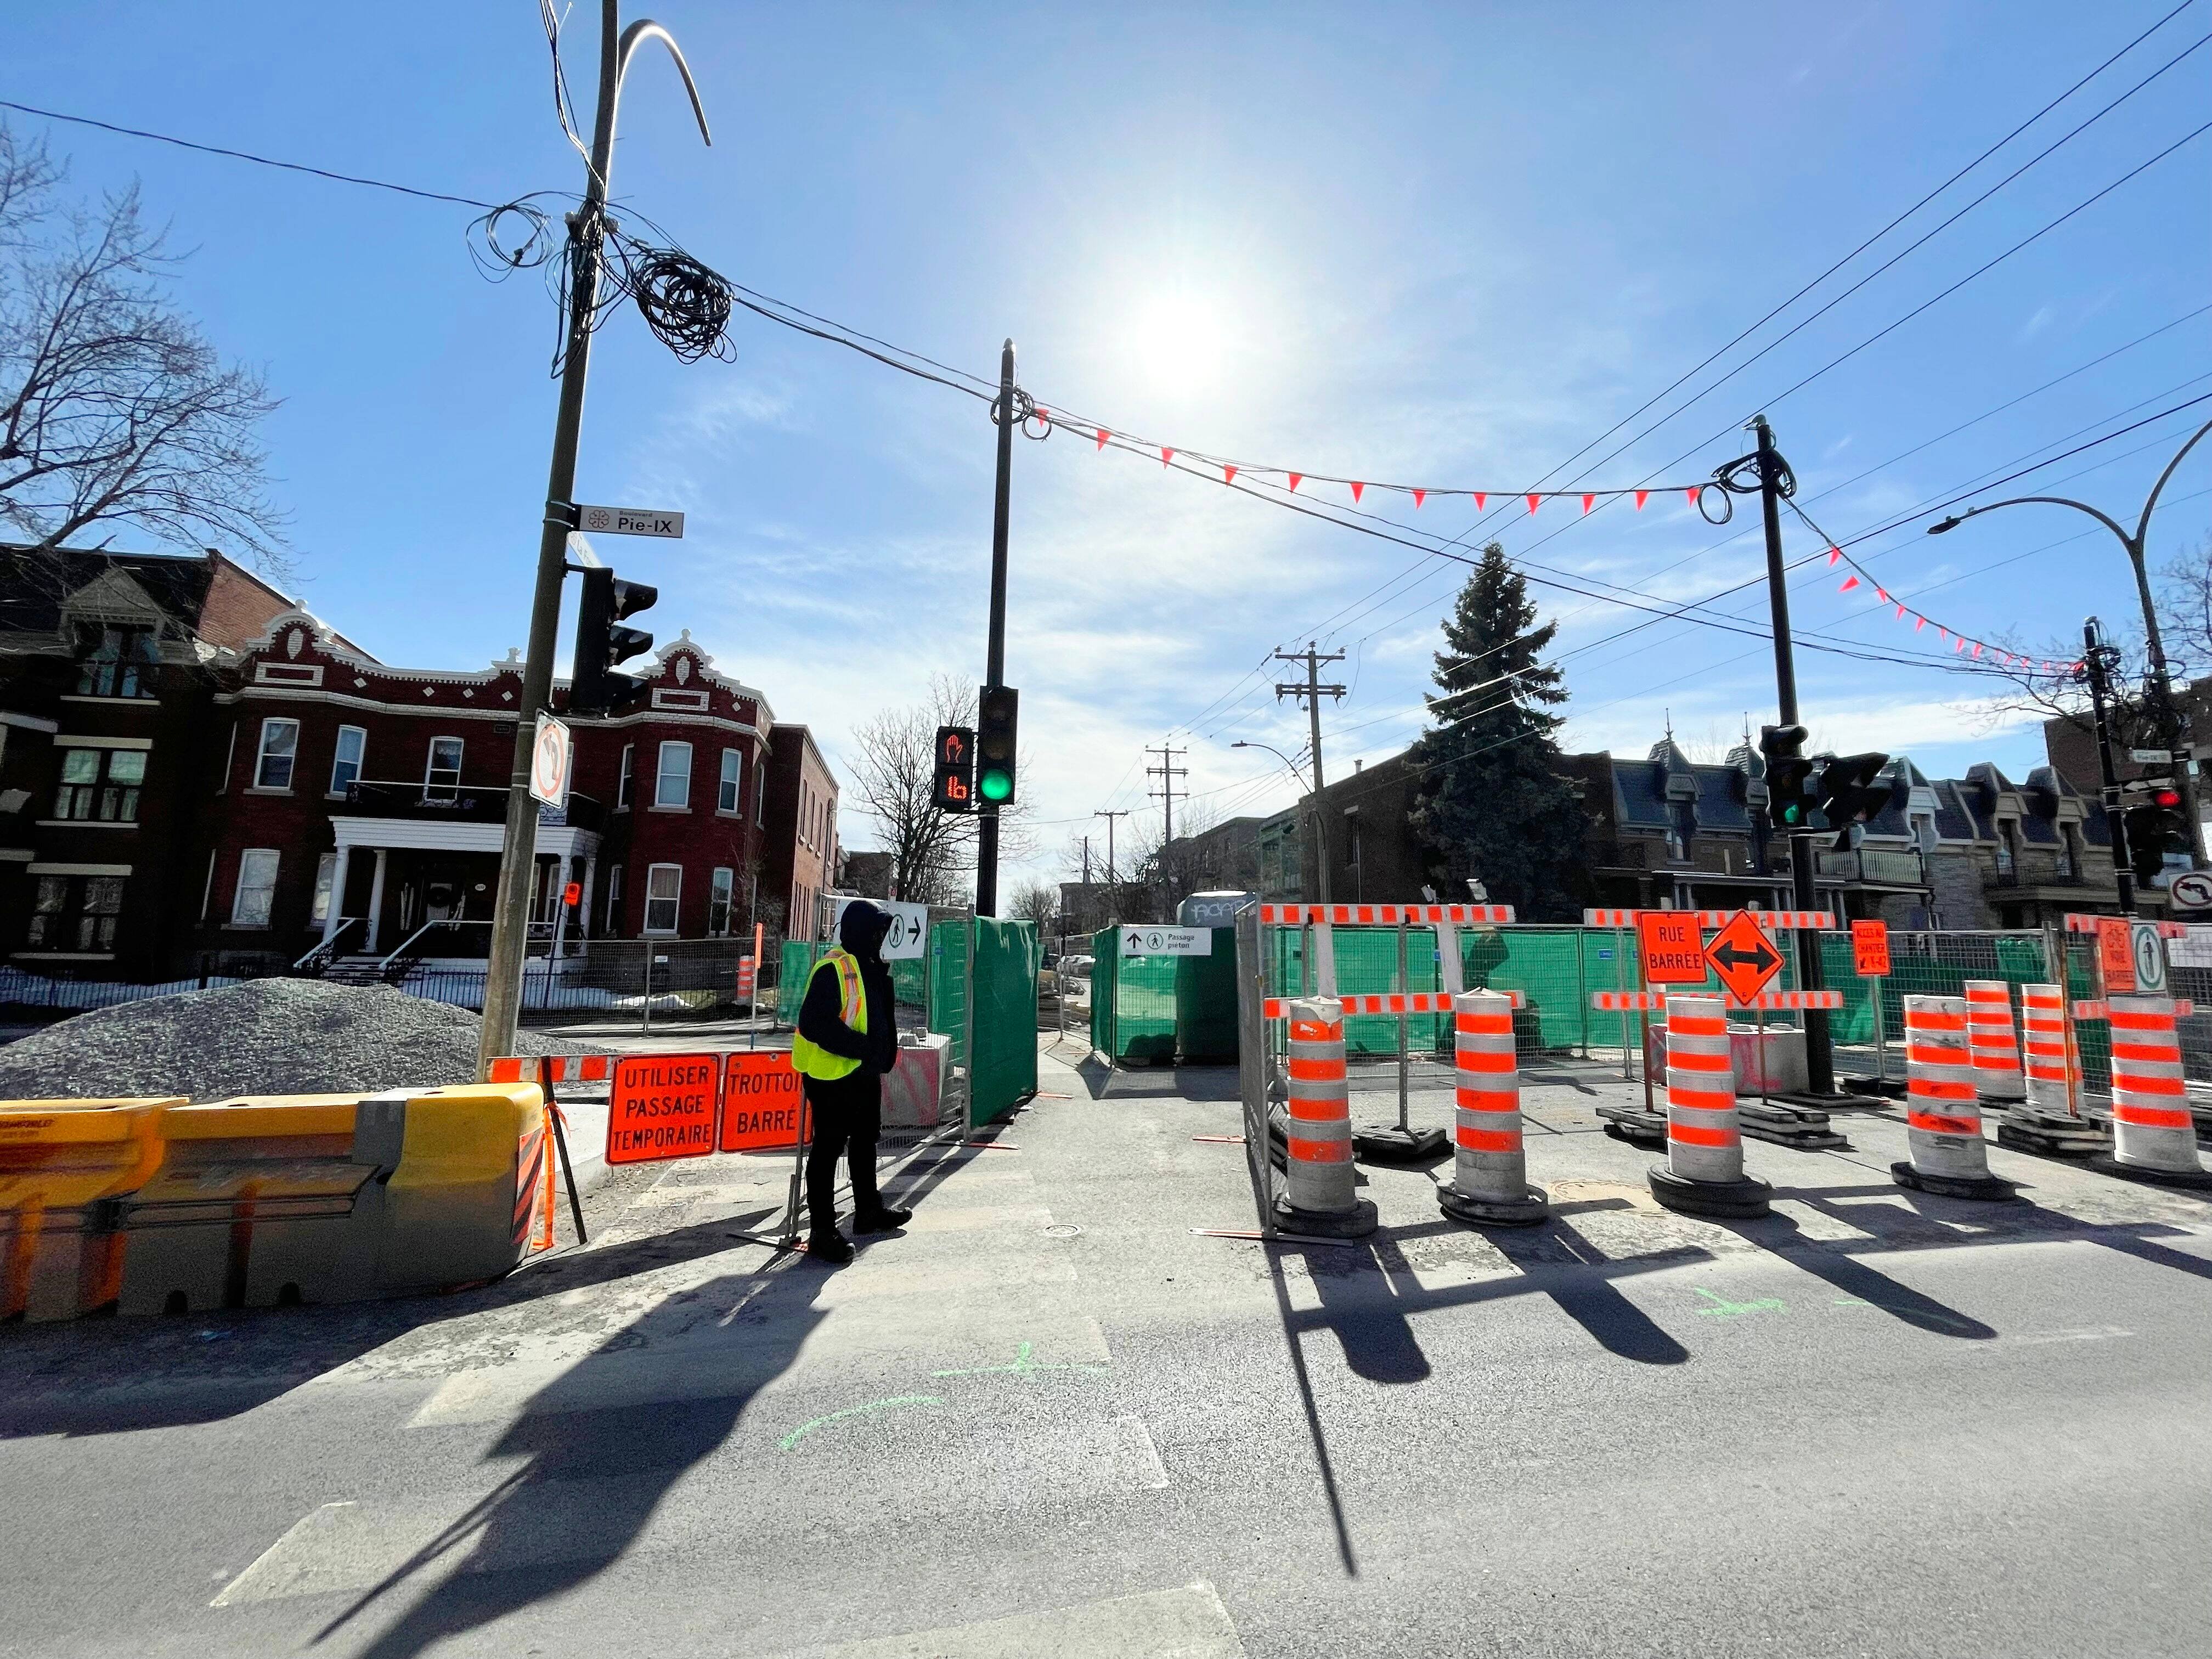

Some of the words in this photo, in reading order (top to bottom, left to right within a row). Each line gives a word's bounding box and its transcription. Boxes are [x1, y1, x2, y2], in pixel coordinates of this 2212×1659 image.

[618, 517, 672, 533] Pie-IX
[1167, 933, 1195, 942] Passage
[1658, 926, 1685, 942] RUE
[1649, 950, 1701, 969] BARRÉE
[624, 1065, 709, 1088] UTILISER
[730, 1072, 799, 1095] TROTTOI
[625, 1094, 706, 1119] PASSAGE
[737, 1103, 796, 1134] BARRÉ
[614, 1124, 712, 1151] TEMPORAIRE
